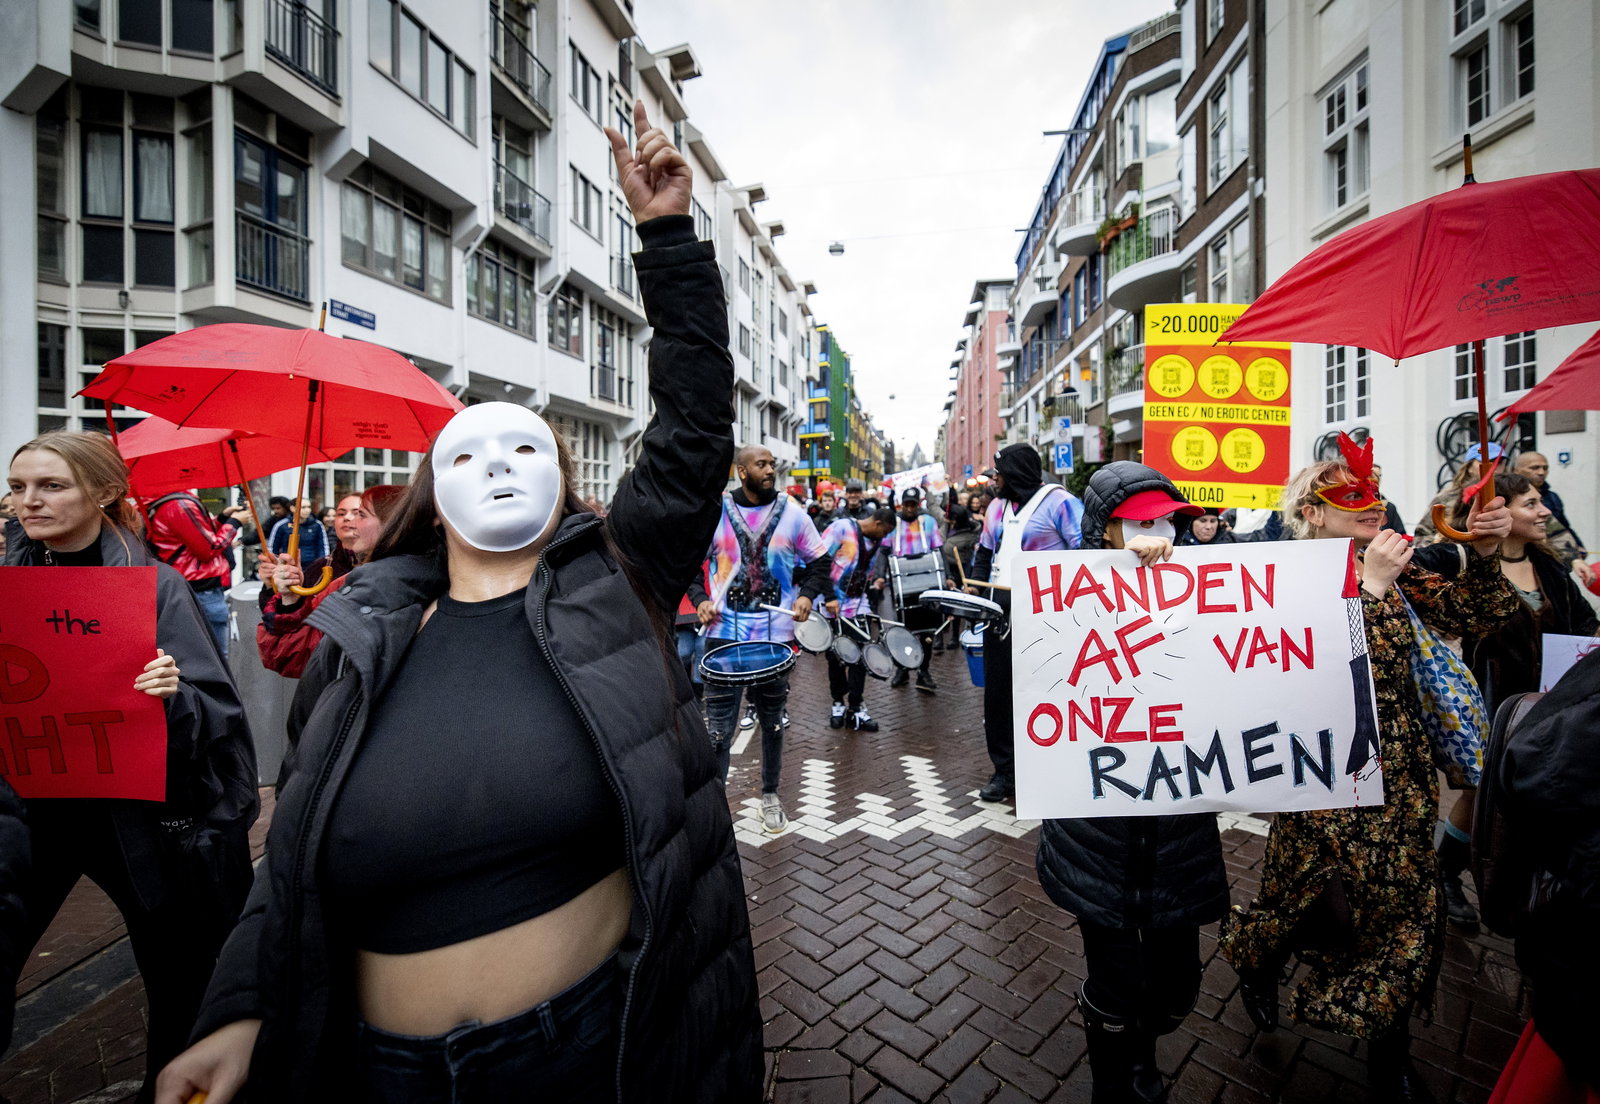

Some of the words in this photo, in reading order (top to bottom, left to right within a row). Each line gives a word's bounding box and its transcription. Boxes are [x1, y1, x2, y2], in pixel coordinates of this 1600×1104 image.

[1485, 293, 1521, 306] nswp
[1149, 405, 1175, 418] GEEN
[1177, 406, 1190, 418] EC
[1200, 407, 1214, 418] NO
[1216, 407, 1250, 420] EROTIC
[1251, 409, 1287, 422] CENTER
[1058, 445, 1069, 458] P
[1027, 562, 1275, 615] HANDEN
[45, 609, 102, 636] the
[1067, 614, 1165, 687] AF
[1213, 625, 1315, 673] VAN
[0, 710, 125, 777] HT
[1027, 696, 1184, 747] ONZE
[1088, 720, 1337, 802] RAMEN
